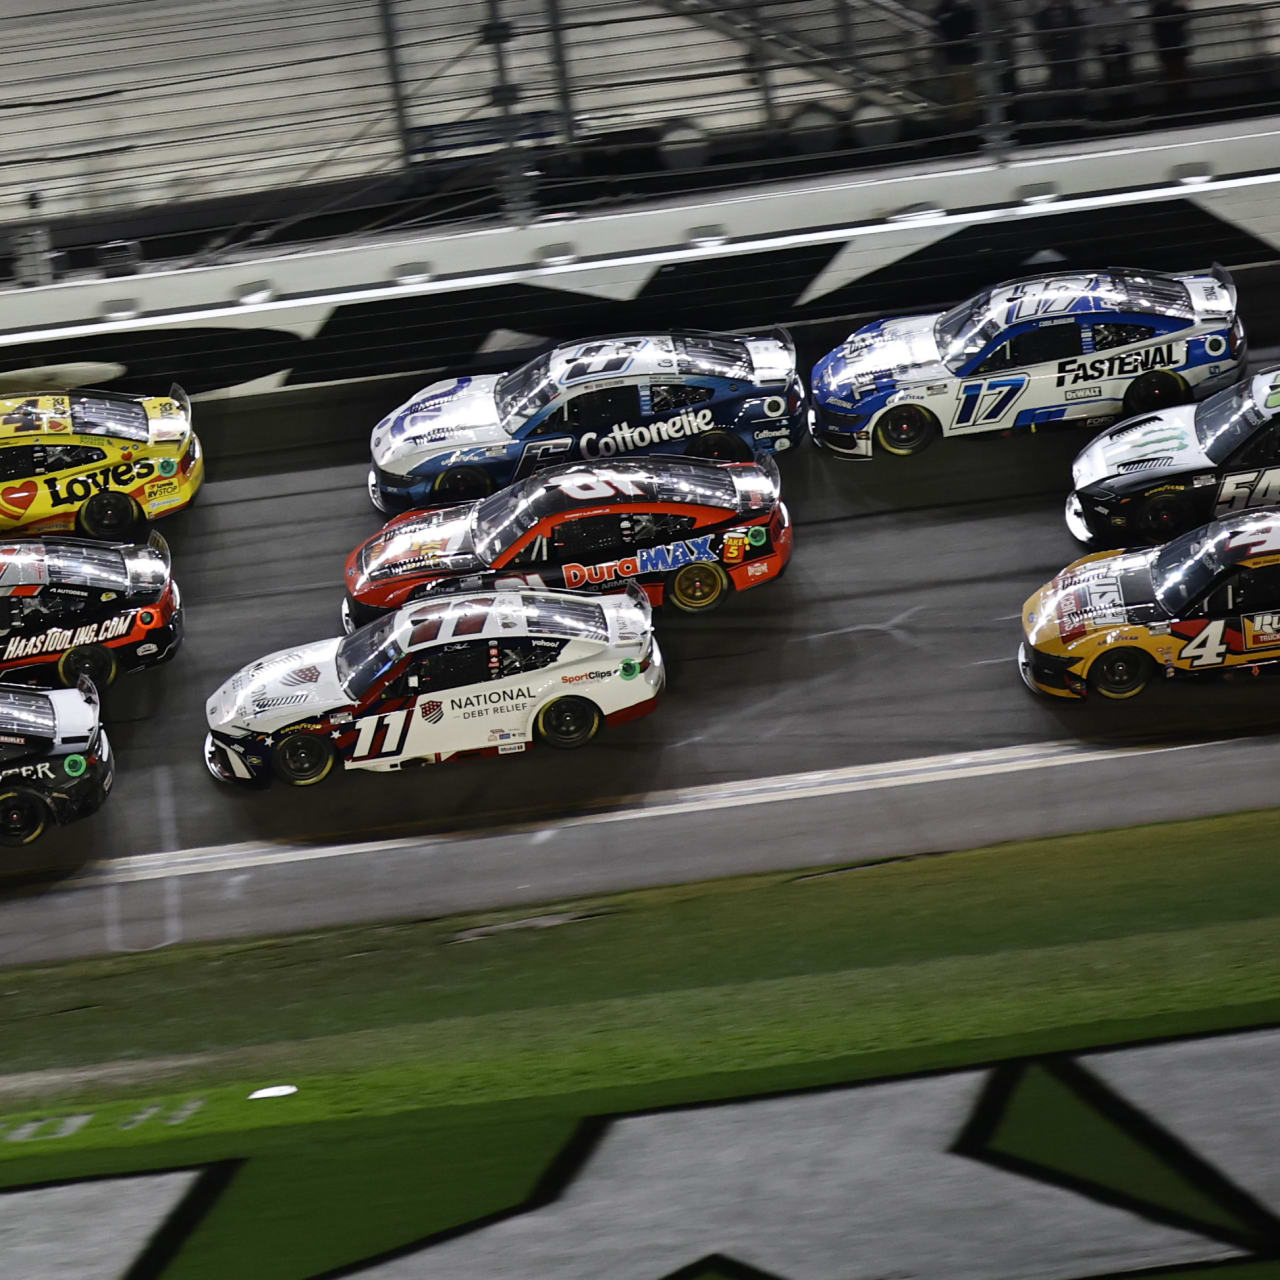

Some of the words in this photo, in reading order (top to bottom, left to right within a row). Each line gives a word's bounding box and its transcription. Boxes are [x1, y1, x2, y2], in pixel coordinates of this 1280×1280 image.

[1056, 344, 1180, 387] FASTENAL
[951, 373, 1030, 429] 17
[580, 409, 714, 459] Cottonelle
[725, 538, 743, 547] TAKE
[727, 546, 739, 558] 5
[532, 639, 560, 649] yahoo!
[1179, 619, 1229, 668] 4
[450, 686, 536, 710] NATIONAL
[462, 708, 490, 719] DEBT
[492, 703, 528, 715] RELIEF
[352, 709, 411, 758] 11
